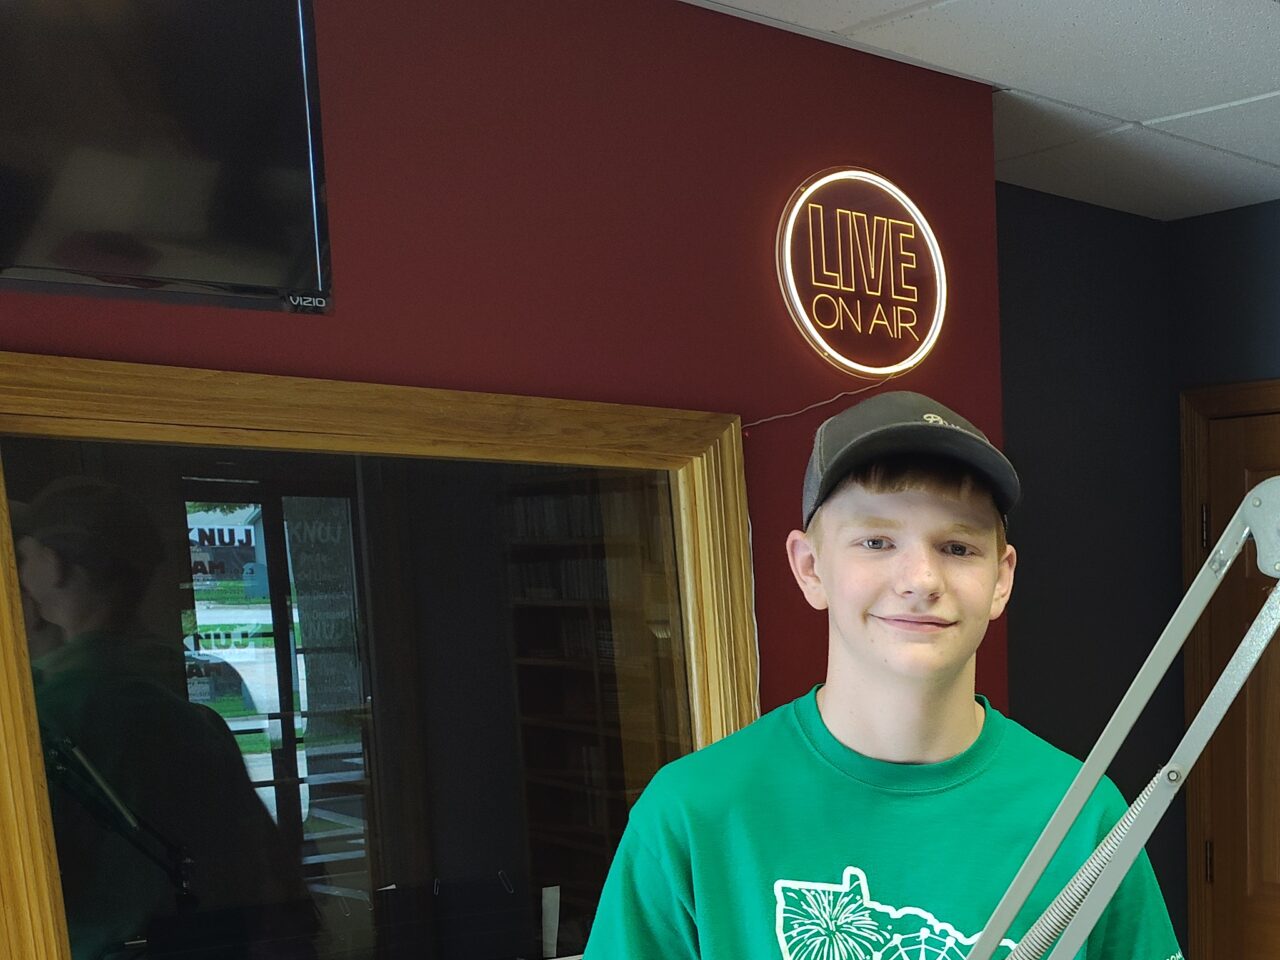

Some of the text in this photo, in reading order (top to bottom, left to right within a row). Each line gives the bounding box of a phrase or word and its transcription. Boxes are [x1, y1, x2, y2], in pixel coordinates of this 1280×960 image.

[808, 203, 918, 302] LIVE
[289, 296, 326, 307] VIZIO
[812, 294, 920, 341] ON AIR
